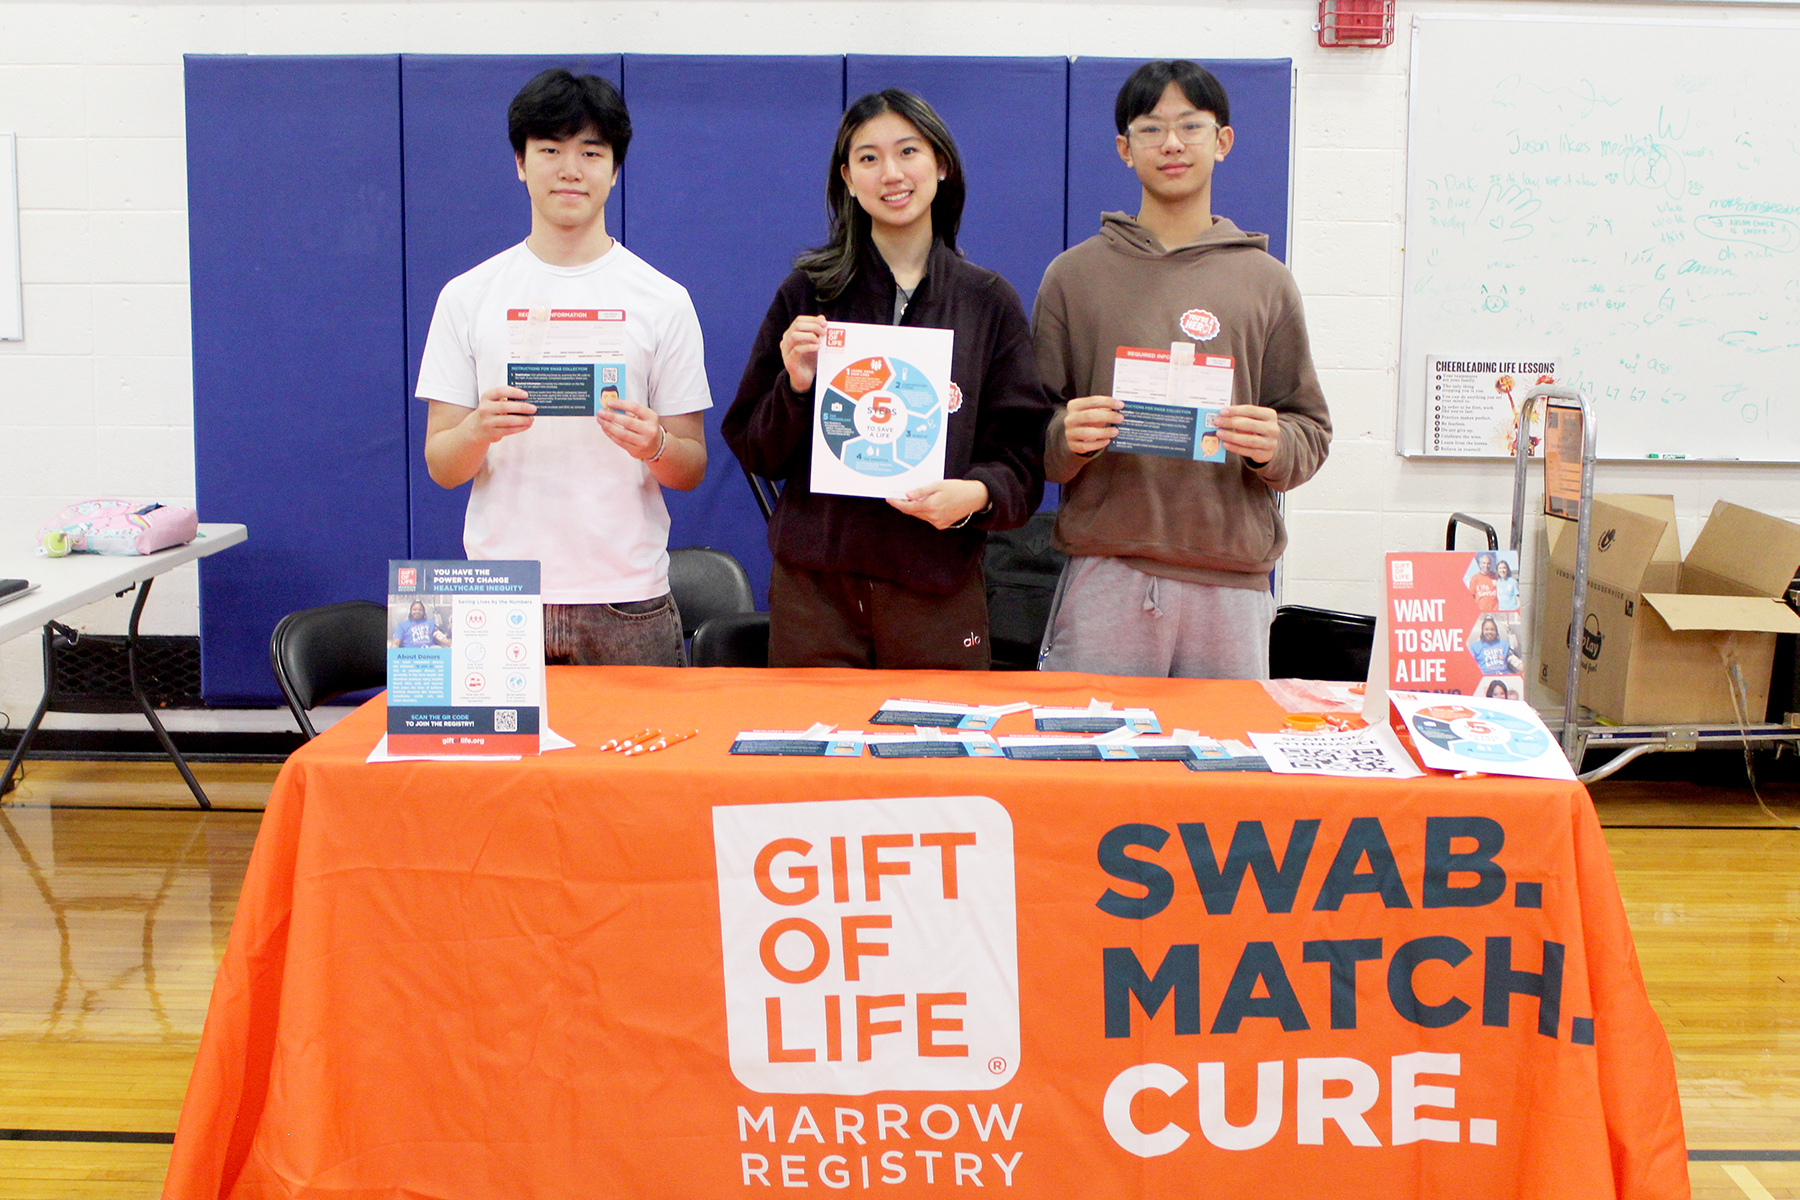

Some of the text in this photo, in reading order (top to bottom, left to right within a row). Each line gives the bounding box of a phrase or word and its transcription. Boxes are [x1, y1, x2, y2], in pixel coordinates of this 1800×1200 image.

[1507, 128, 1550, 154] Jason
[1560, 133, 1591, 155] likes
[1185, 319, 1214, 334] HERO!
[1188, 313, 1210, 324] YOU'RE
[827, 339, 843, 347] LIFE
[1127, 351, 1156, 359] REQUIRED
[1436, 361, 1555, 374] CHEERLEADING LIFE LESSONS
[895, 381, 901, 389] 2
[823, 412, 829, 420] 5
[867, 406, 898, 416] STEPS
[870, 396, 892, 424] 5
[433, 568, 490, 576] YOU HAVE THE
[433, 576, 509, 584] POWER TO CHANGE
[433, 584, 484, 592] HEALTHCARE
[1394, 599, 1446, 622] WANT
[1395, 628, 1464, 653] TO SAVE
[1395, 659, 1447, 682] A LIFE
[443, 720, 475, 728] REGISTRY!
[1466, 721, 1492, 734] 5
[754, 831, 977, 906] GIFT
[1095, 815, 1543, 920] SWAB.
[758, 914, 893, 984] OF
[1102, 934, 1596, 1047] MATCH.
[765, 991, 969, 1063] LIFE
[1102, 1050, 1498, 1159] CURE.
[737, 1102, 1024, 1146] MARROW
[741, 1150, 1024, 1190] REGISTRY
